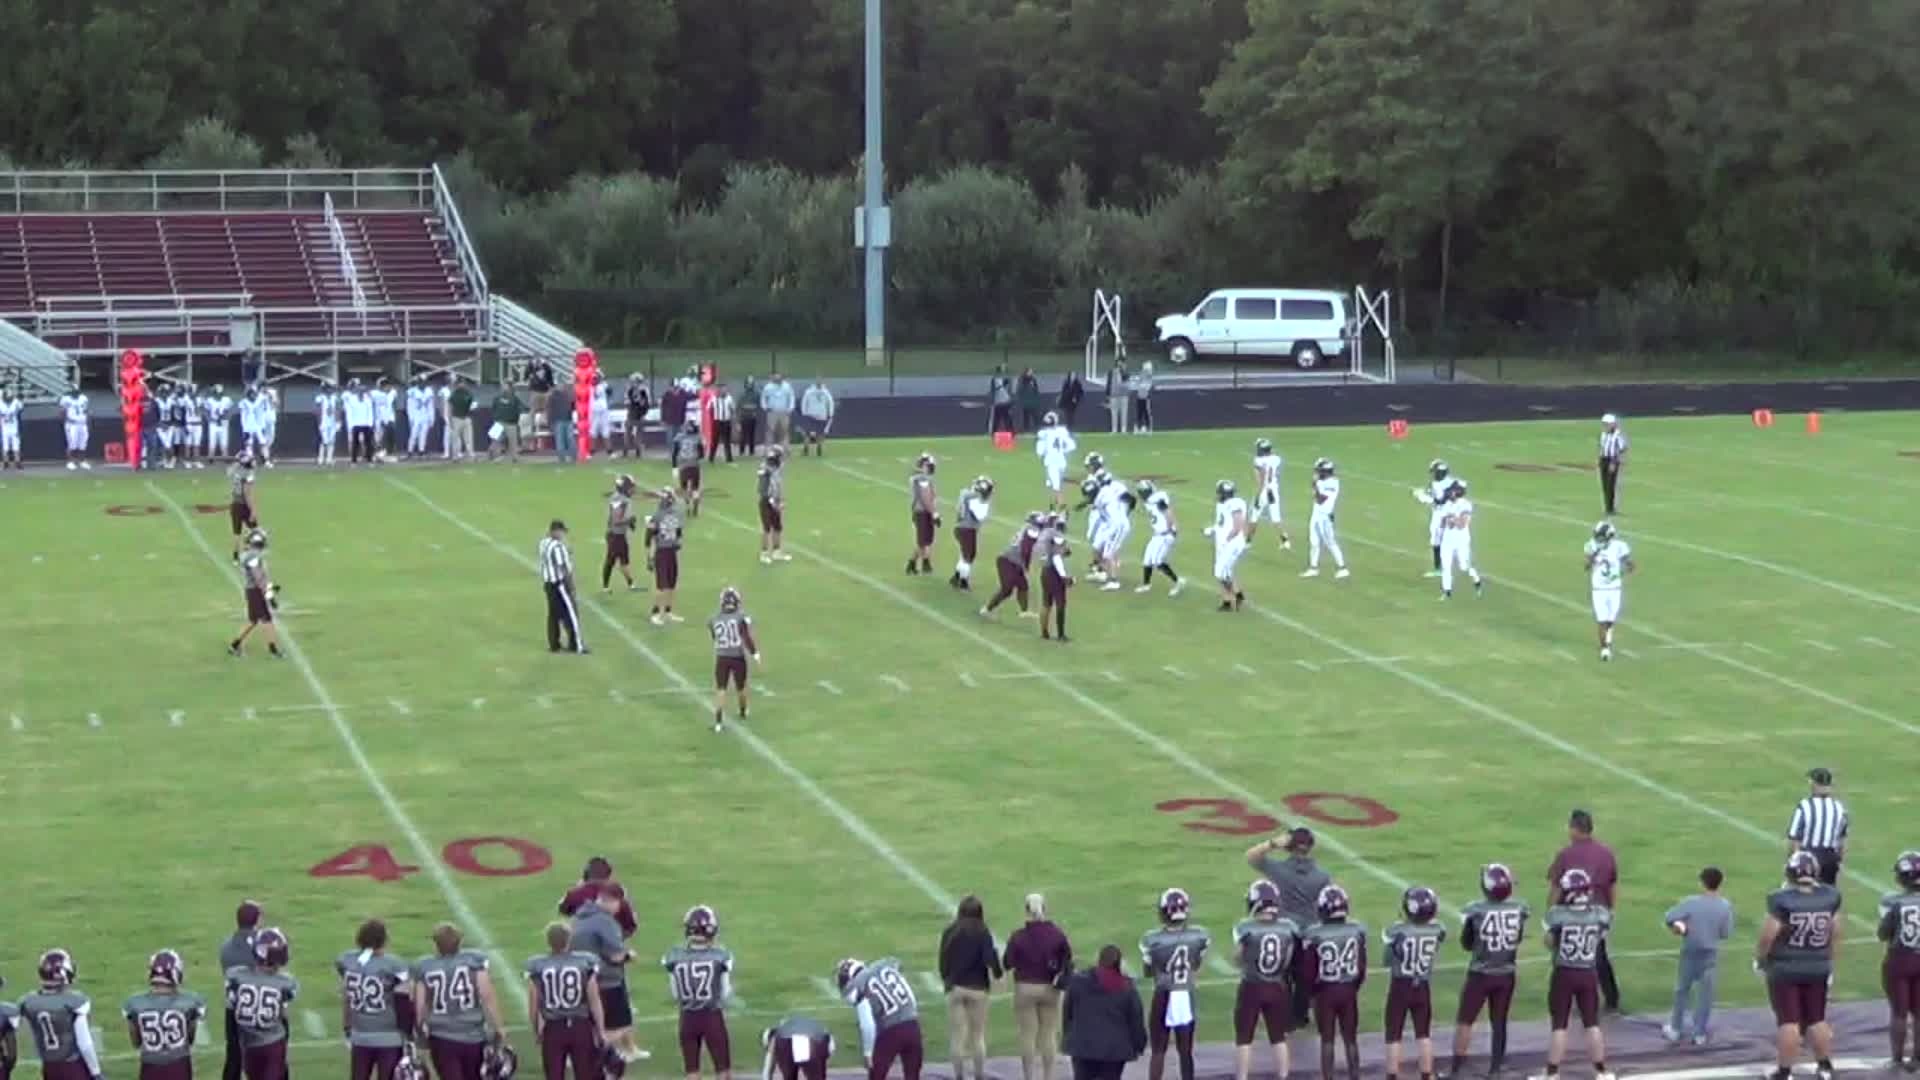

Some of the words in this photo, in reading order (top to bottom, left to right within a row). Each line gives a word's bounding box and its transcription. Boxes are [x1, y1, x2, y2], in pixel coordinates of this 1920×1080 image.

[1154, 792, 1399, 835] 30
[308, 837, 552, 881] 40
[1480, 910, 1521, 951] 45
[1560, 926, 1599, 961] 50
[1789, 912, 1832, 946] 79
[1166, 945, 1190, 984] 4
[1258, 934, 1281, 974] 8
[1318, 937, 1359, 982] 24
[1401, 935, 1437, 975] 15
[345, 971, 386, 1013] 52
[425, 966, 475, 1014] 74
[542, 967, 582, 1009] 18
[675, 962, 713, 1000] 17
[235, 984, 281, 1028] 25
[37, 1011, 60, 1050] 1
[138, 1010, 187, 1050] 53
